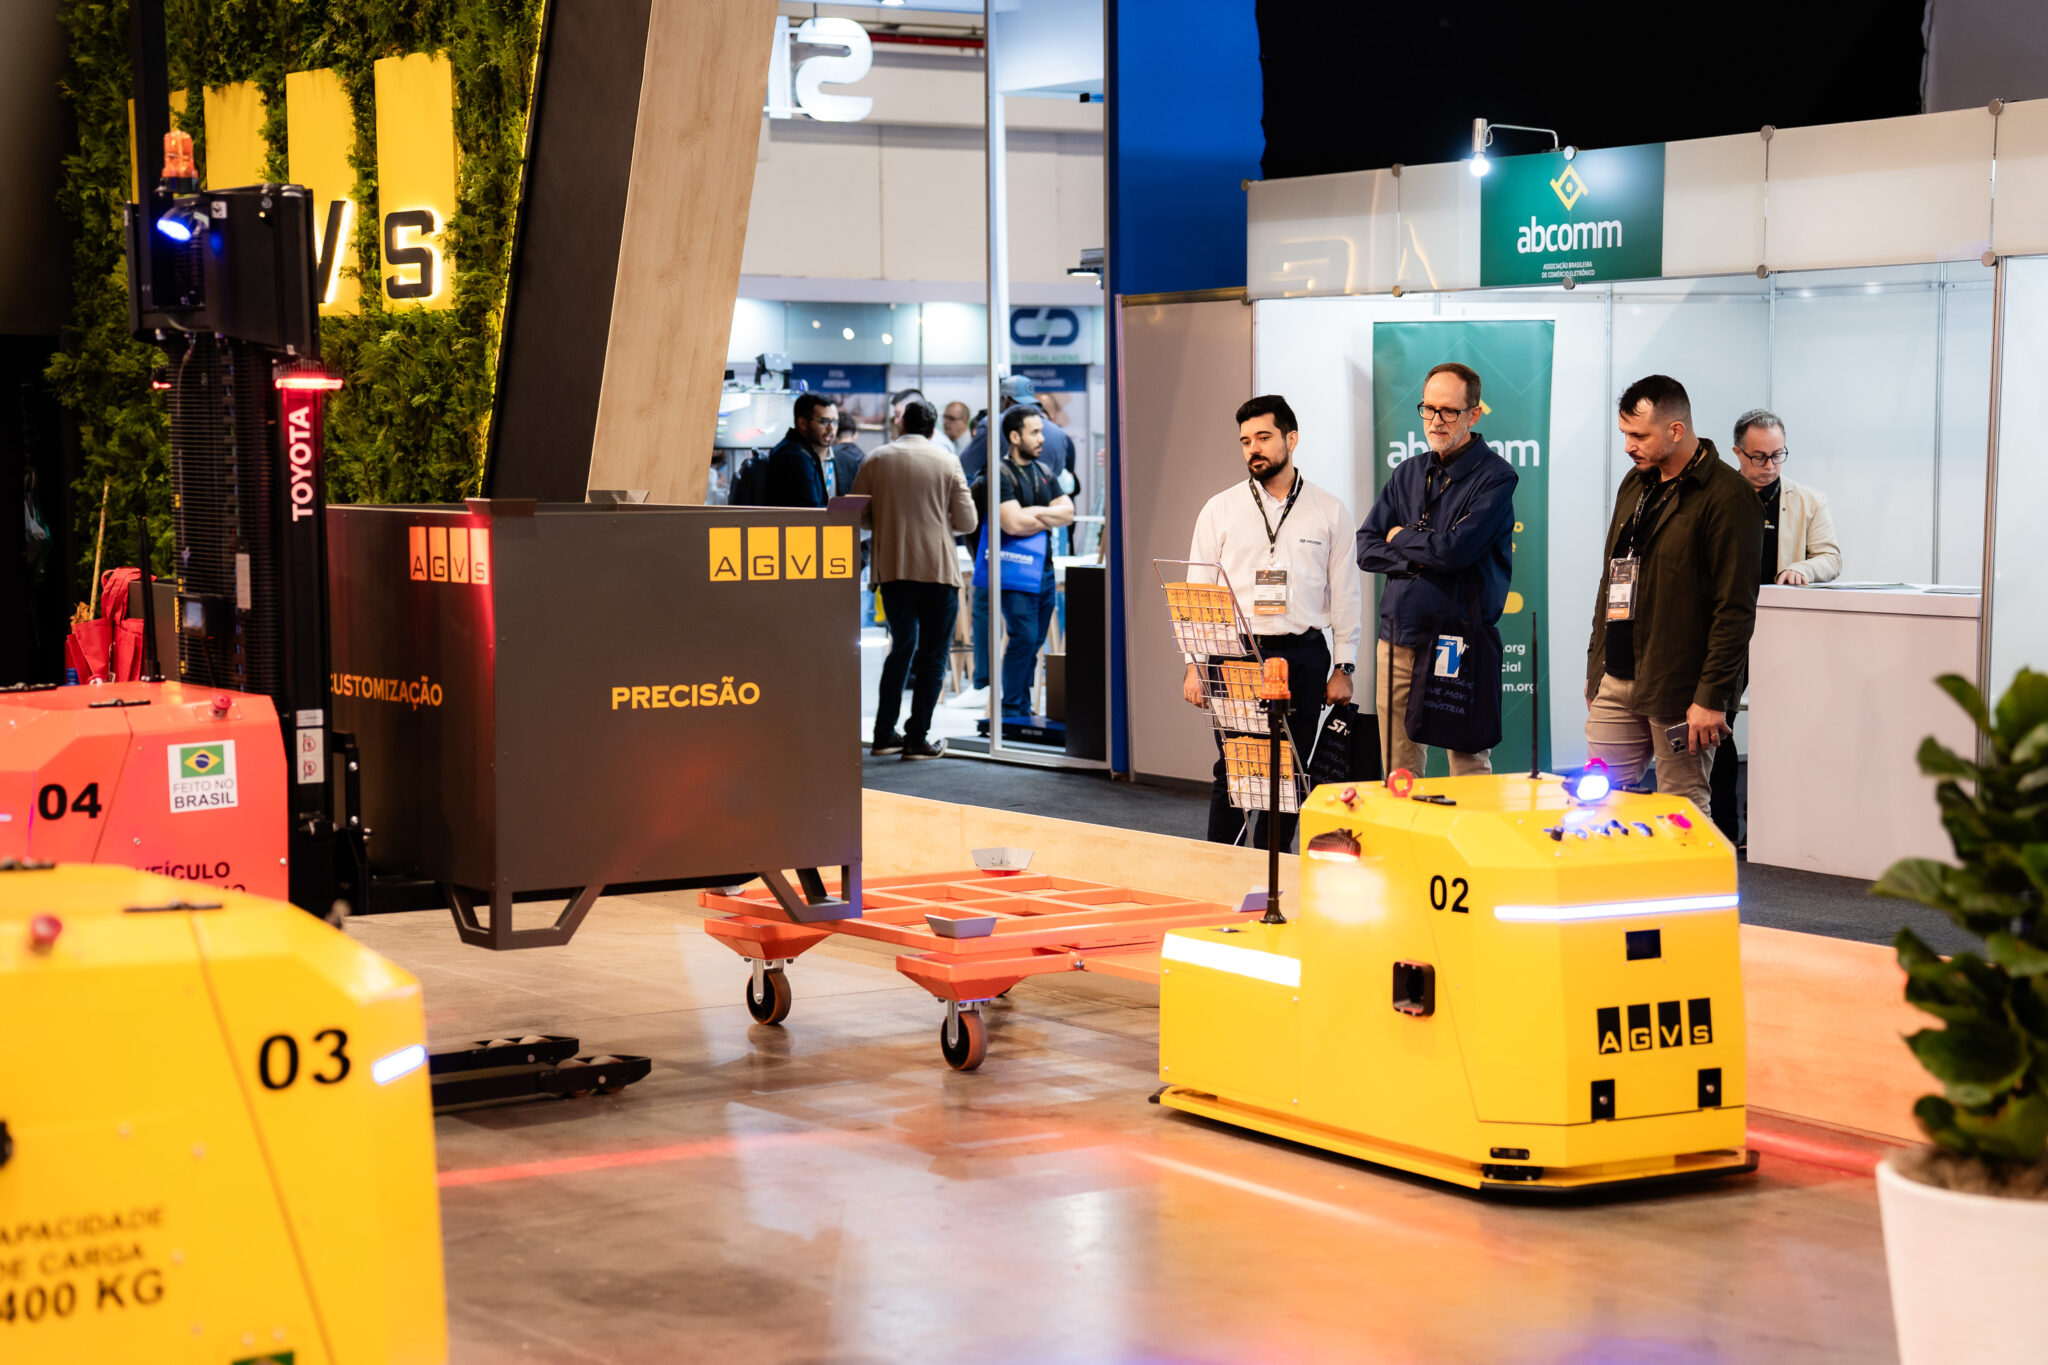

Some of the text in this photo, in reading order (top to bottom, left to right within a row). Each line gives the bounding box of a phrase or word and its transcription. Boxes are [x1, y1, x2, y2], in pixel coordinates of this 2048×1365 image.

[1517, 215, 1623, 253] abcomm
[1542, 260, 1593, 270] ASSOCIAÇÃO BRASILEIRA
[1570, 268, 1595, 277] ELETRÔNICO
[288, 406, 314, 522] TOYOTA
[330, 673, 442, 711] USTOMIZAÇÃO
[611, 676, 760, 710] PRECISÃO
[38, 783, 102, 820] 04
[173, 778, 234, 794] FEITO NO
[174, 792, 235, 809] BRASIL
[144, 861, 230, 880] EÍCULO
[1430, 875, 1469, 913] 02
[259, 1029, 350, 1090] 03
[0, 1207, 162, 1245] APACIDADE
[97, 1268, 164, 1311] KG
